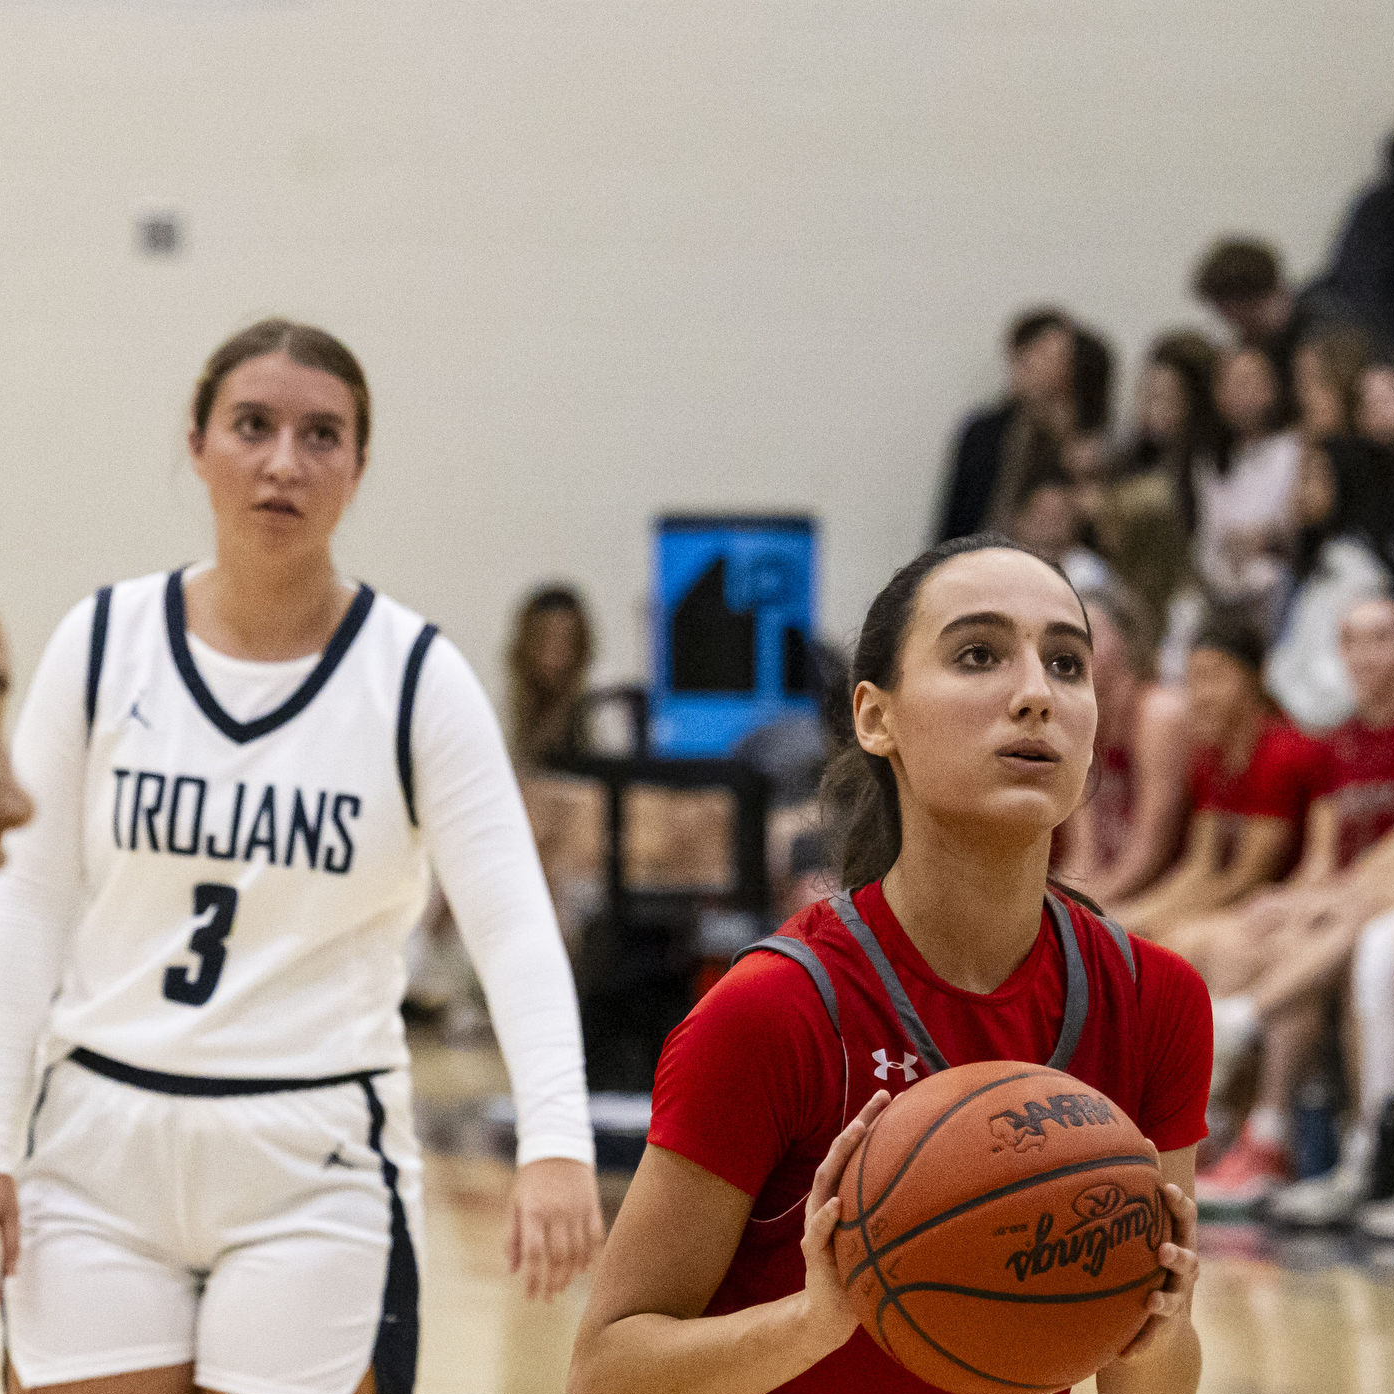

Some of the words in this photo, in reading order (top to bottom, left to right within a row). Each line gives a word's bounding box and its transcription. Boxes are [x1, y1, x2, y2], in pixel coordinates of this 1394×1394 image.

[113, 768, 361, 875] TROJANS
[162, 882, 239, 1007] 3
[1005, 1184, 1165, 1282] Rawlings
